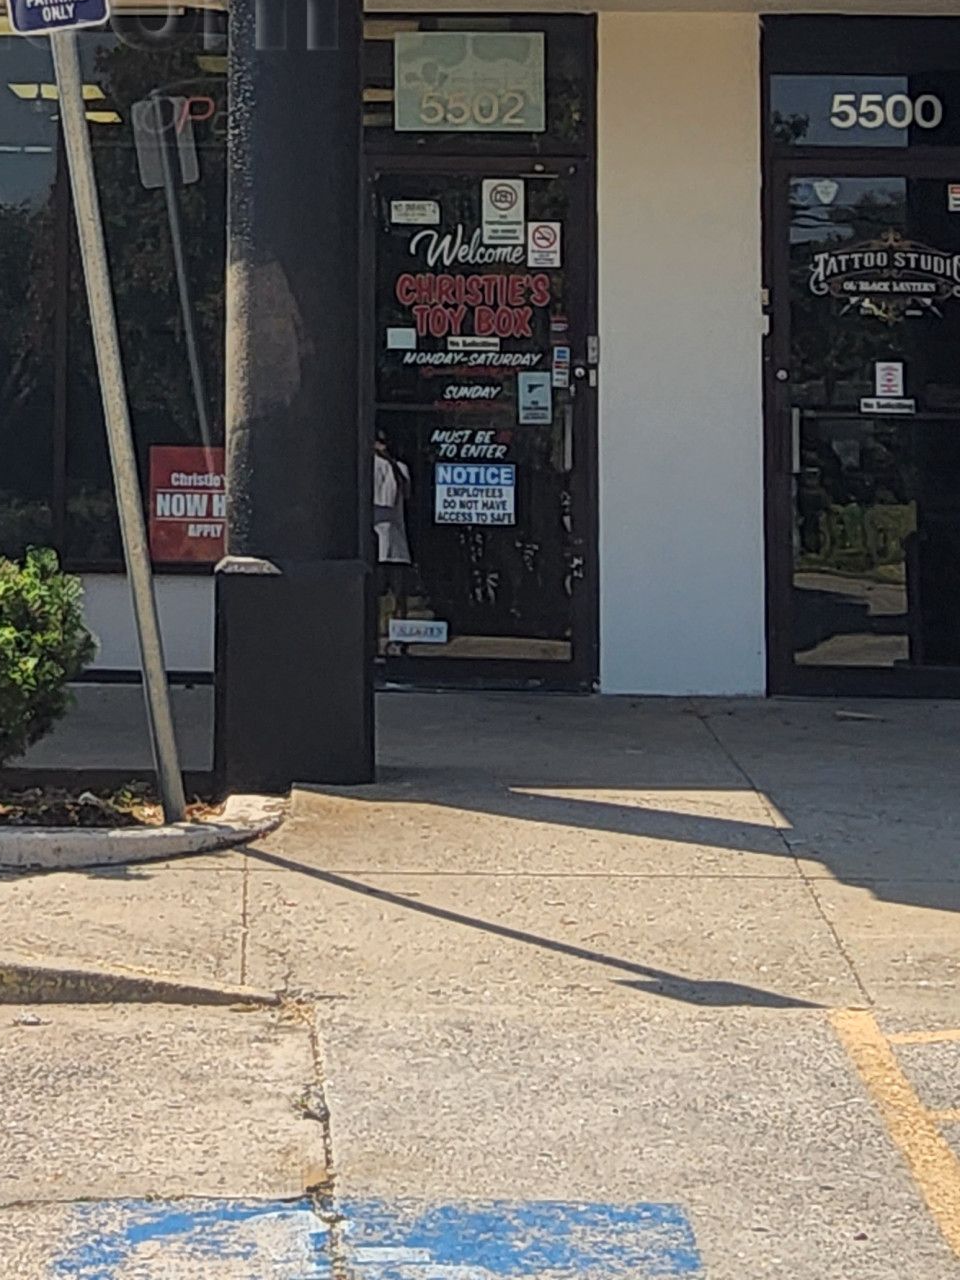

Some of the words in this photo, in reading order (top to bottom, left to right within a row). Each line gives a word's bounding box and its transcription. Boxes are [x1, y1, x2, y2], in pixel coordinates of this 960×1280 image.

[41, 3, 76, 23] ONLY
[419, 91, 526, 125] 5502
[830, 92, 943, 131] 5500
[410, 224, 527, 268] Welcome
[808, 251, 889, 293] TATTOO
[396, 273, 551, 306] CHRISTIE'S
[413, 307, 467, 337] TOY
[474, 306, 533, 337] BOX
[403, 351, 543, 366] MONDAY-SATURDAY
[443, 385, 502, 399] SUNDAY
[430, 429, 473, 444] MUST
[474, 430, 496, 444] BE
[438, 444, 458, 458] TO
[460, 444, 508, 459] ENTER
[438, 467, 514, 485] NOTICE
[446, 487, 505, 498] EMPLOYEES
[156, 493, 208, 517] NOW
[442, 499, 456, 509] DO
[459, 499, 479, 510] NOT
[481, 500, 509, 511] HAVE
[437, 510, 474, 522] ACCESS
[475, 511, 489, 522] TO
[187, 524, 223, 538] APPLY
